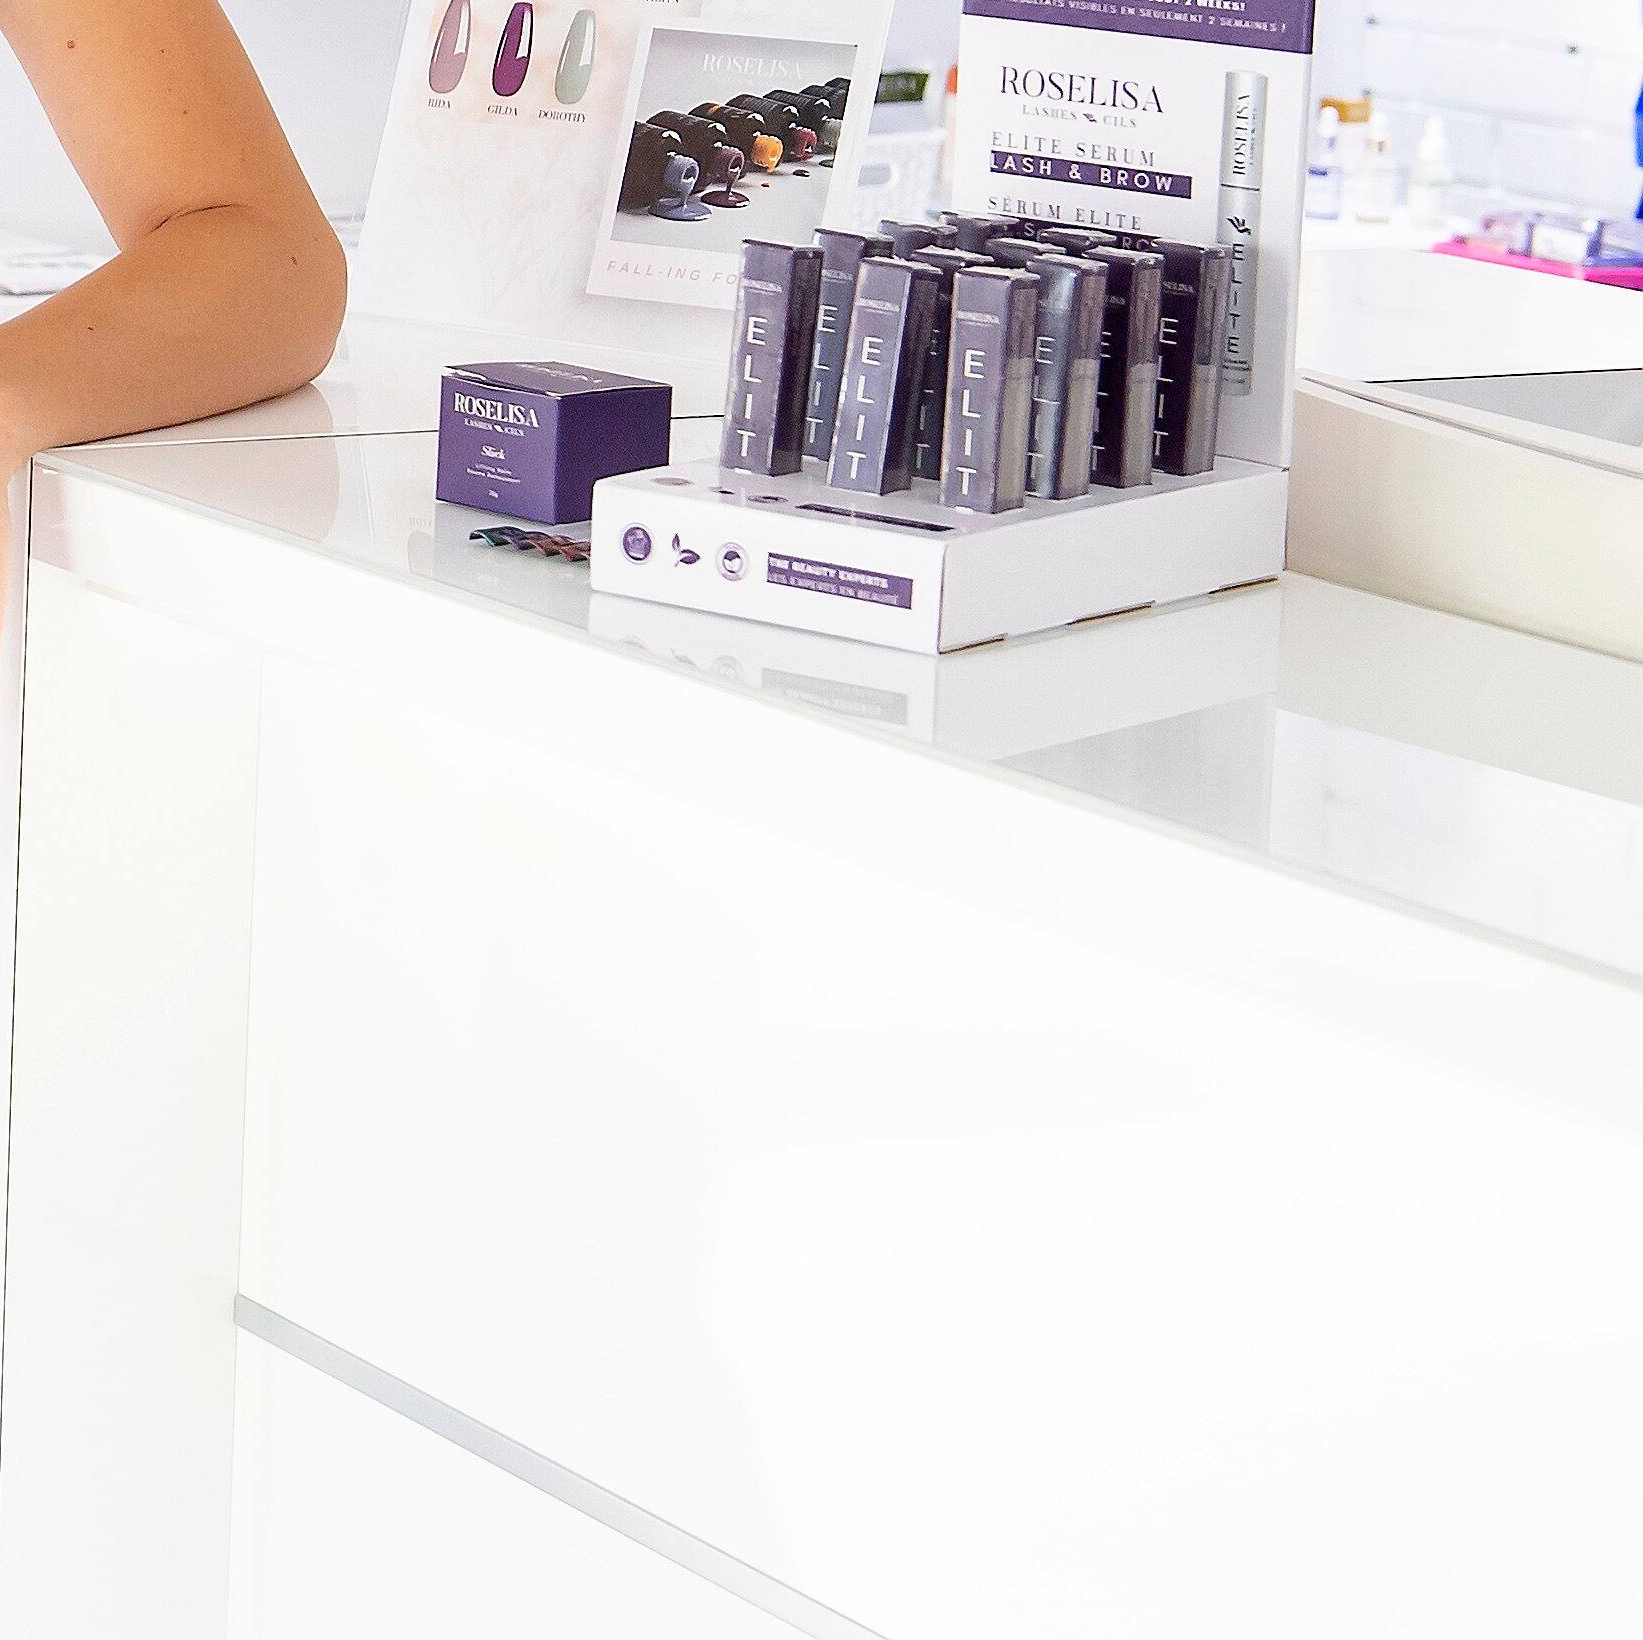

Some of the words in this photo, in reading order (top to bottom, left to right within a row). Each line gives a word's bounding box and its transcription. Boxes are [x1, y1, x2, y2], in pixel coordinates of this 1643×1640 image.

[701, 53, 804, 79] ROSELISA
[1000, 65, 1164, 114] ROSELISA
[487, 104, 519, 116] GILDA
[1022, 104, 1078, 121] LASHES
[991, 130, 1062, 154] ELITE
[1075, 142, 1155, 167] SERUM
[990, 151, 1052, 176] LASH
[1068, 164, 1083, 181] &
[1099, 168, 1173, 191] BROW
[1075, 208, 1142, 231] ELITE
[712, 271, 738, 285] FO
[735, 316, 769, 458] ELIT
[805, 304, 838, 444] ELIT
[1153, 317, 1179, 456] ELIT
[454, 392, 540, 429] ROSELISA
[846, 336, 884, 480] ELIT
[956, 348, 987, 496] ELIT
